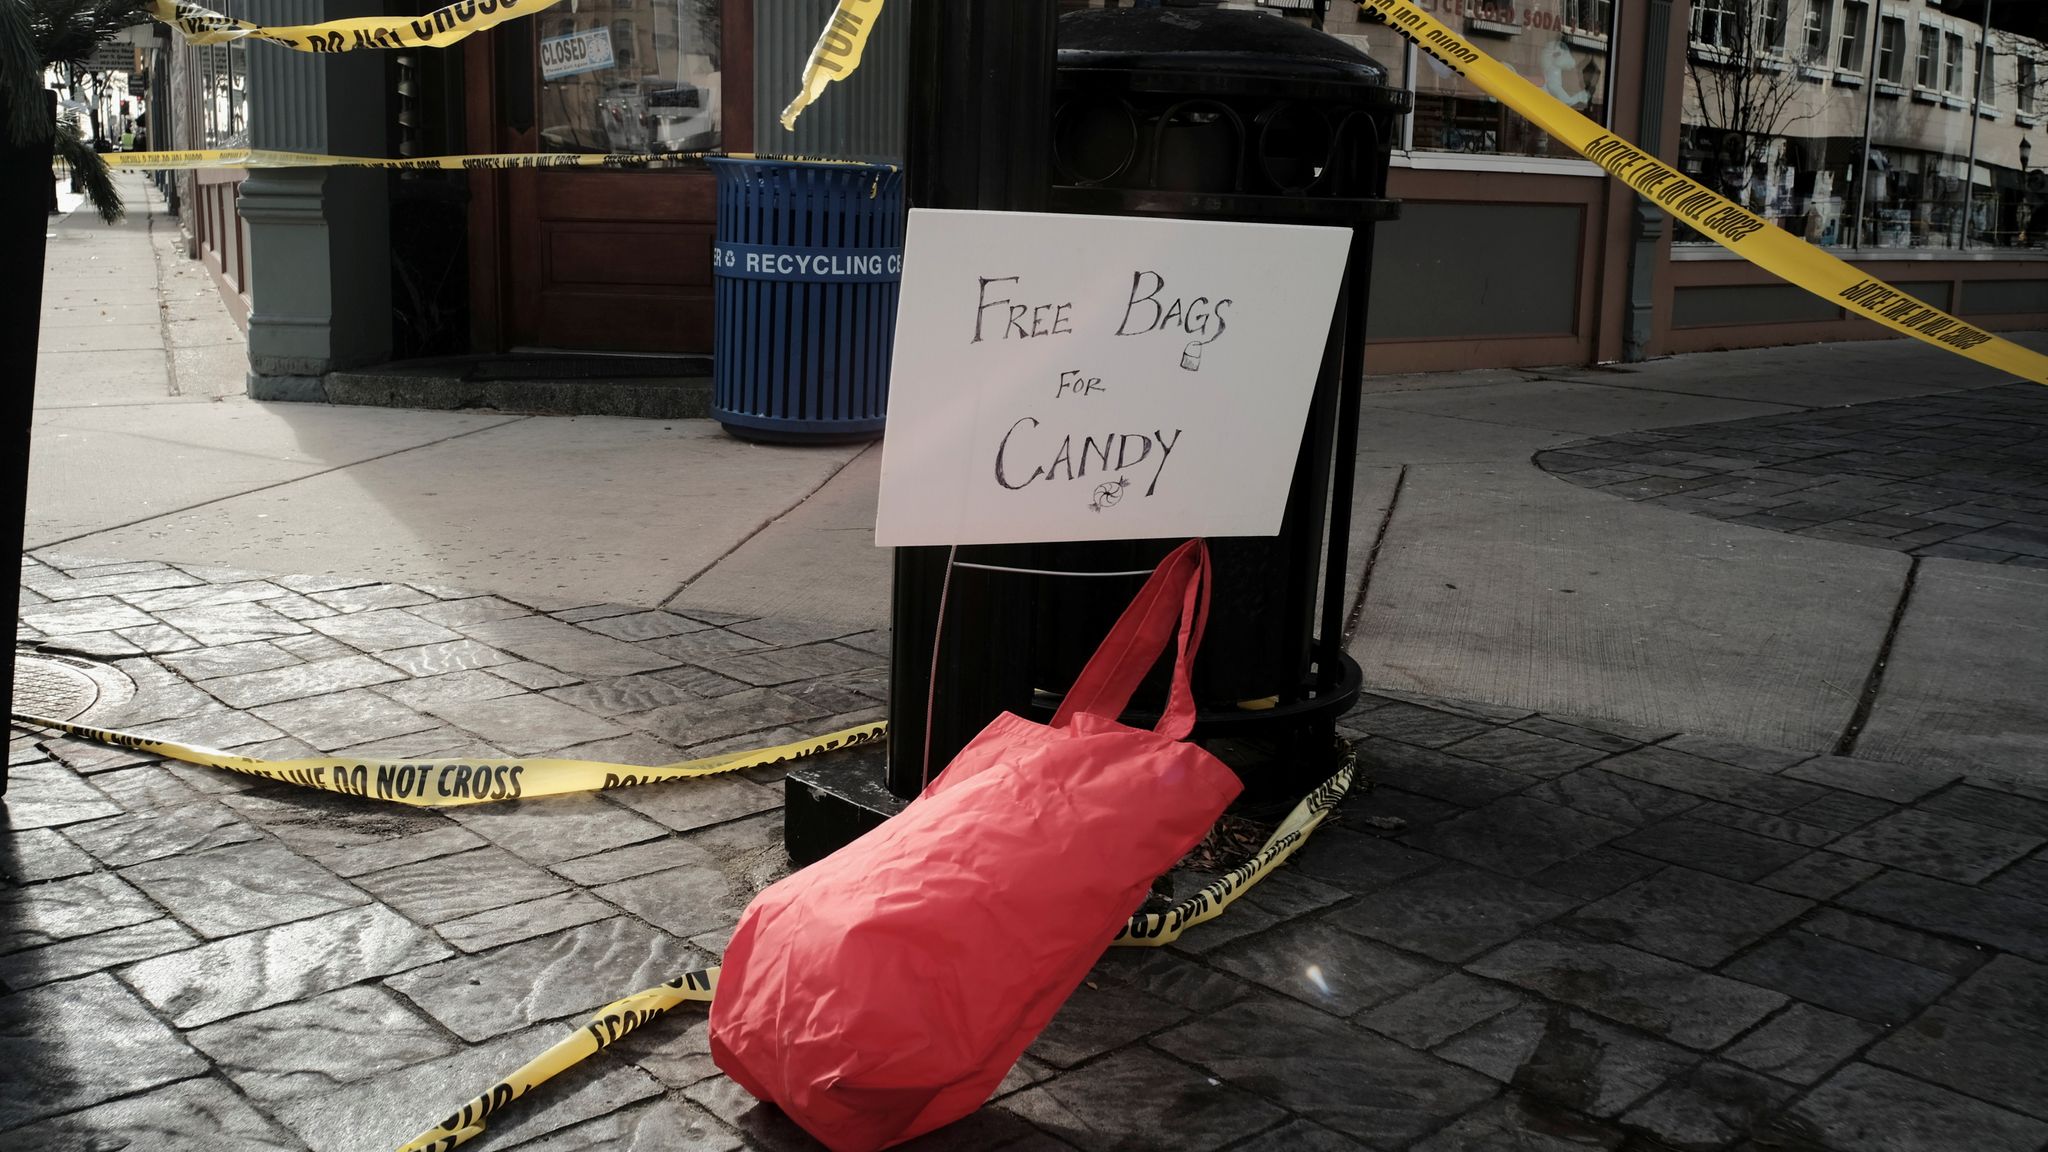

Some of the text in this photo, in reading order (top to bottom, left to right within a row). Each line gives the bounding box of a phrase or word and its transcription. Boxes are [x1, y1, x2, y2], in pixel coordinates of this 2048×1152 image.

[1523, 9, 1563, 32] SODA
[542, 37, 587, 66] CLOSED
[746, 253, 882, 275] RECYCLING
[971, 271, 1232, 345] FREE BAGS
[1056, 370, 1106, 398] FOR
[995, 416, 1182, 498] CANDY
[333, 764, 369, 798] DO
[376, 764, 434, 799] NOT
[437, 765, 524, 800] CROSS
